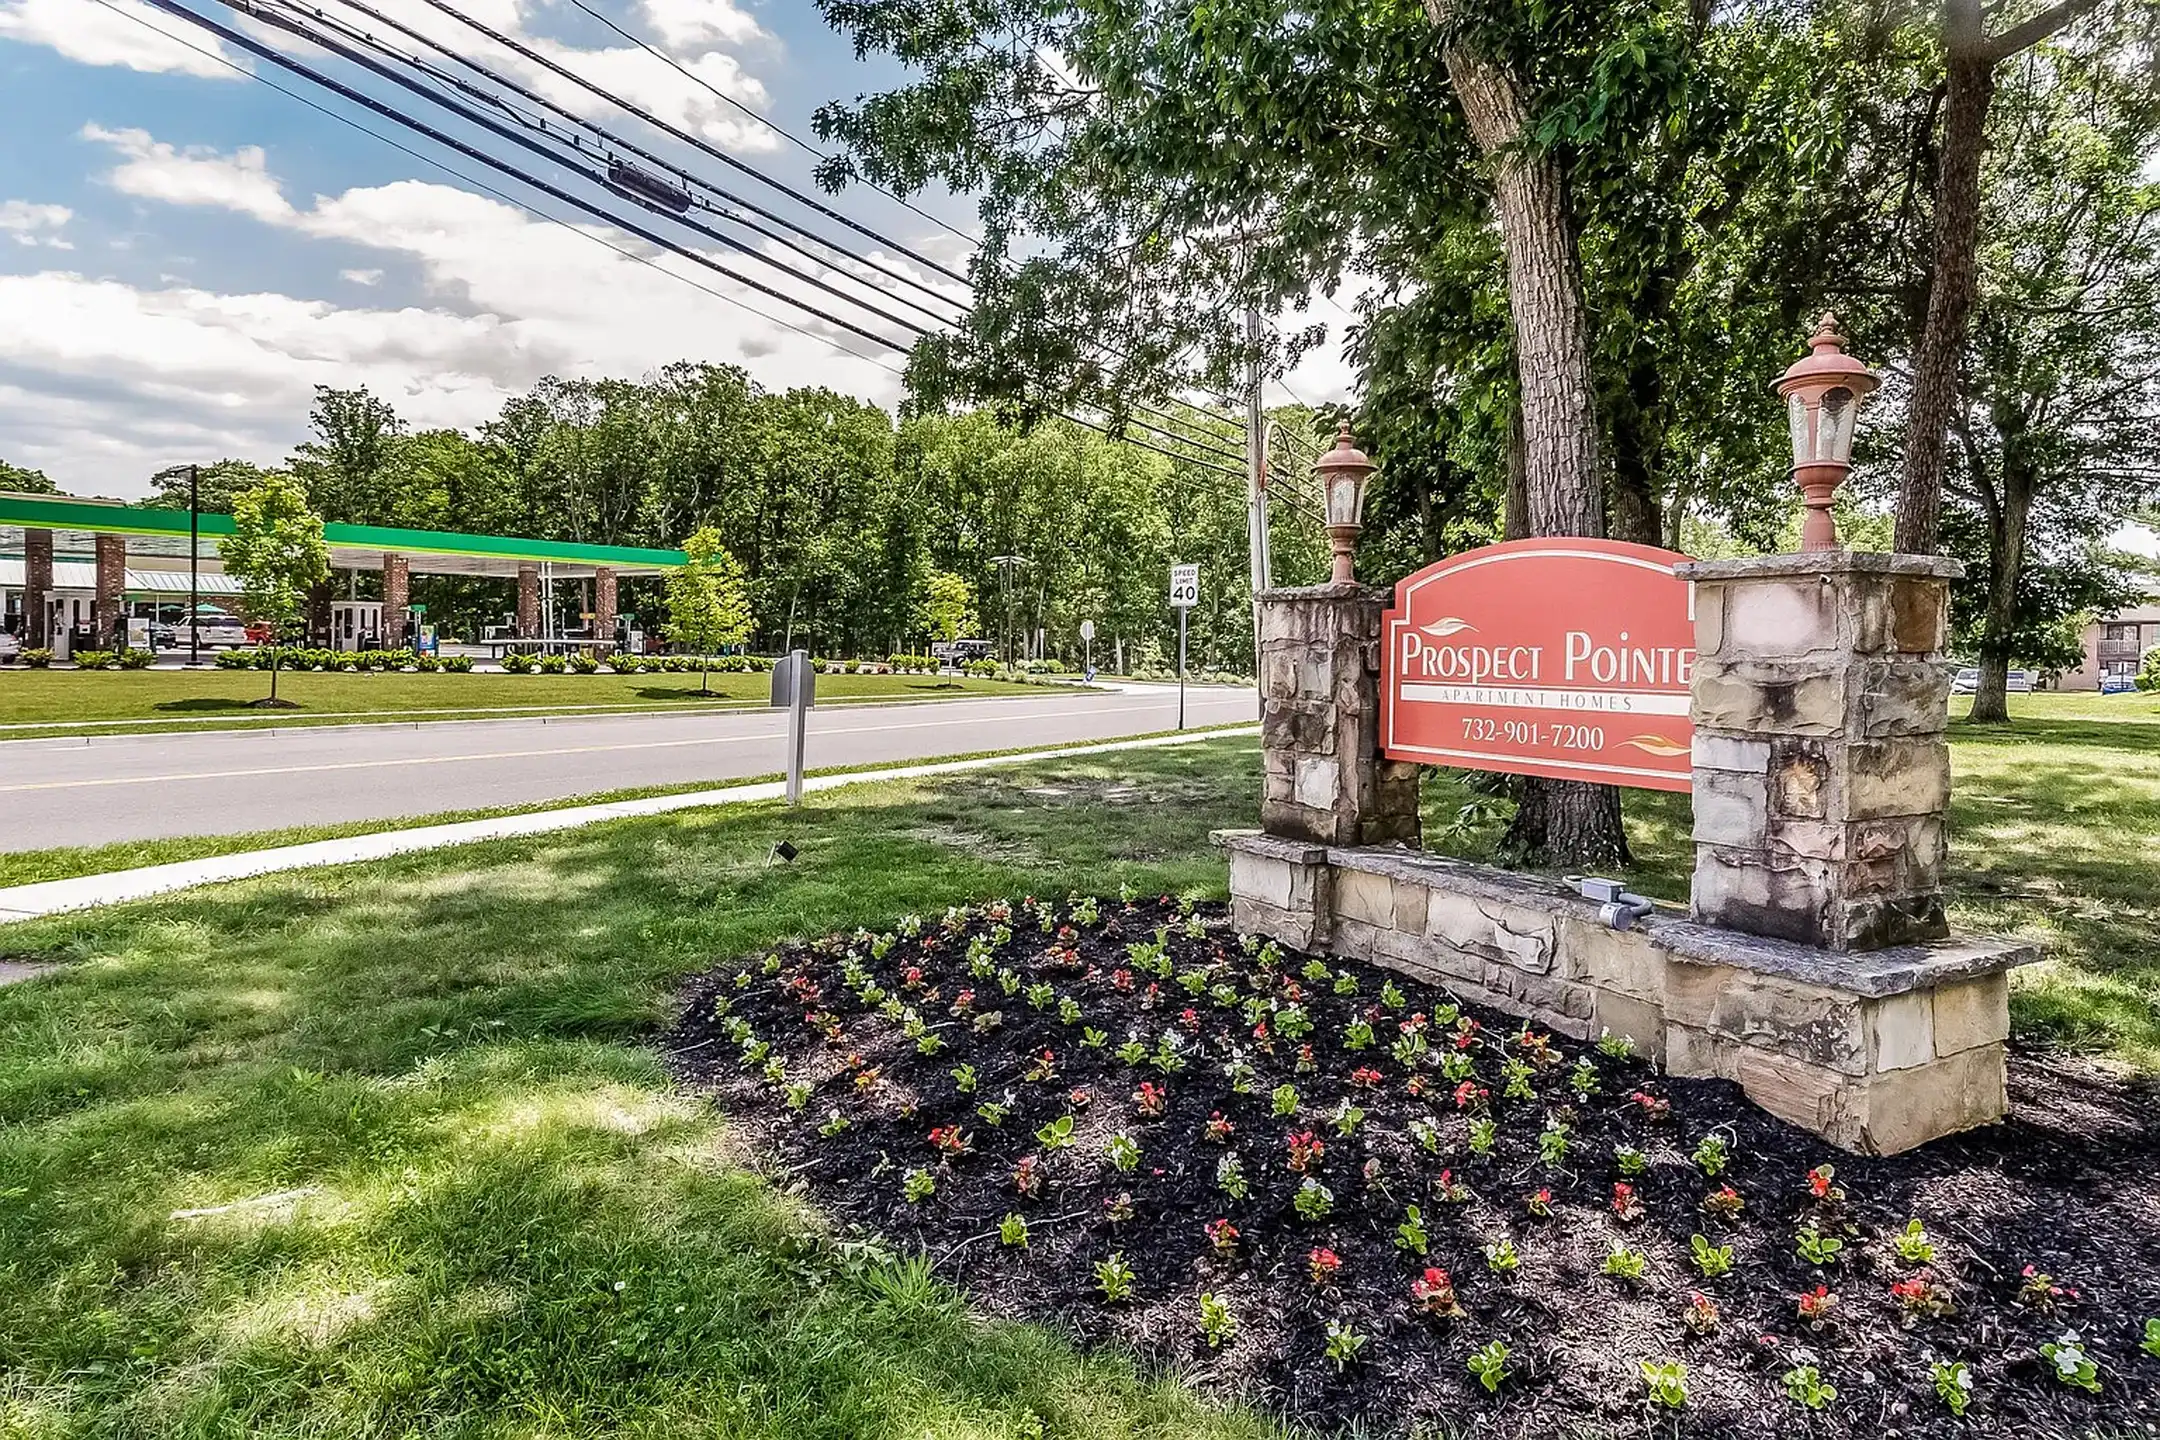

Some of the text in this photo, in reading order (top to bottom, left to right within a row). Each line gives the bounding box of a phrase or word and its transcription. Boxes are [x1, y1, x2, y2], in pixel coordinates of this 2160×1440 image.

[1174, 569, 1196, 577] SPEED
[1175, 577, 1193, 585] LIMIT
[1173, 586, 1195, 600] 40
[1442, 689, 1633, 711] APARTMENT HOMES
[1461, 717, 1605, 751] 732-901-7200
